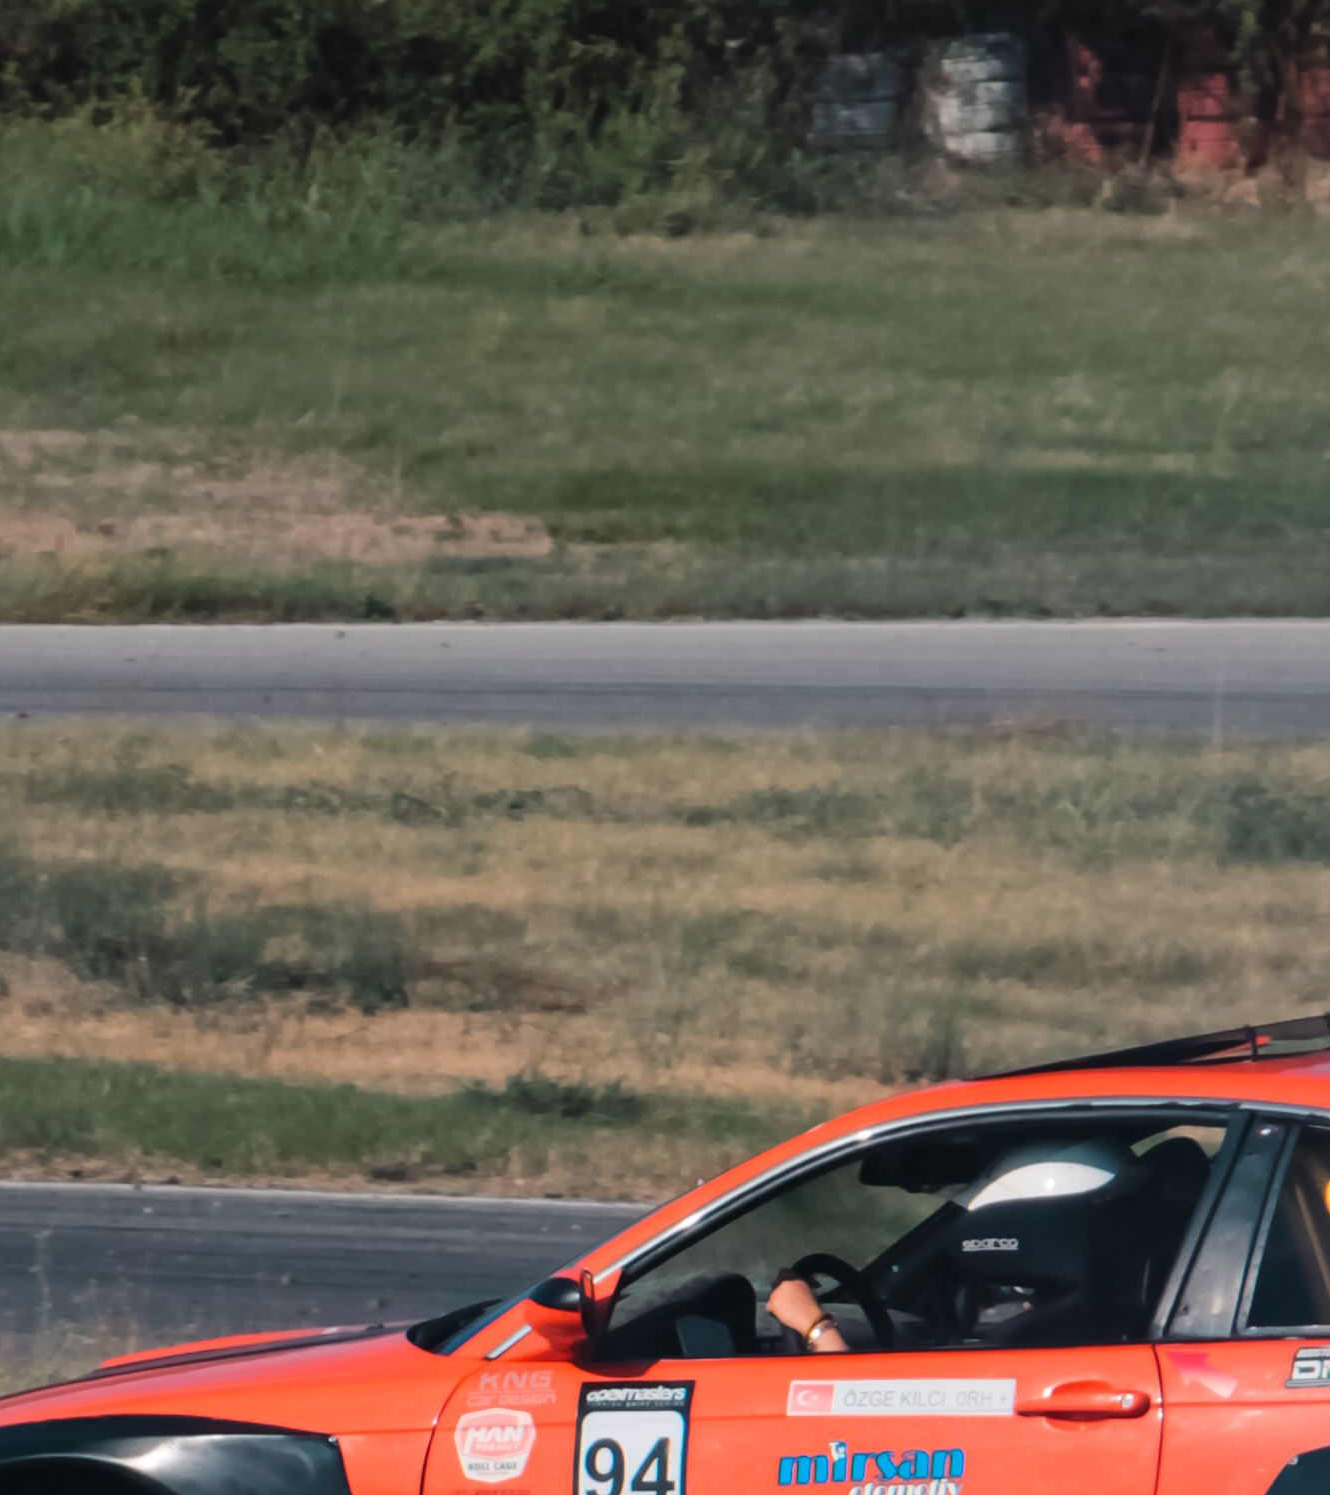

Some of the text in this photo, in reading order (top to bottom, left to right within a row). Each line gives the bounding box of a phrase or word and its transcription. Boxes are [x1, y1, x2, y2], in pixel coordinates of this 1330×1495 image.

[962, 1238, 1018, 1250] sparco
[479, 1370, 553, 1389] KNG
[586, 1385, 687, 1402] apexmasters
[843, 1390, 895, 1408] ÖZGE
[467, 1462, 490, 1471] ROLL
[777, 1440, 966, 1486] mirsan
